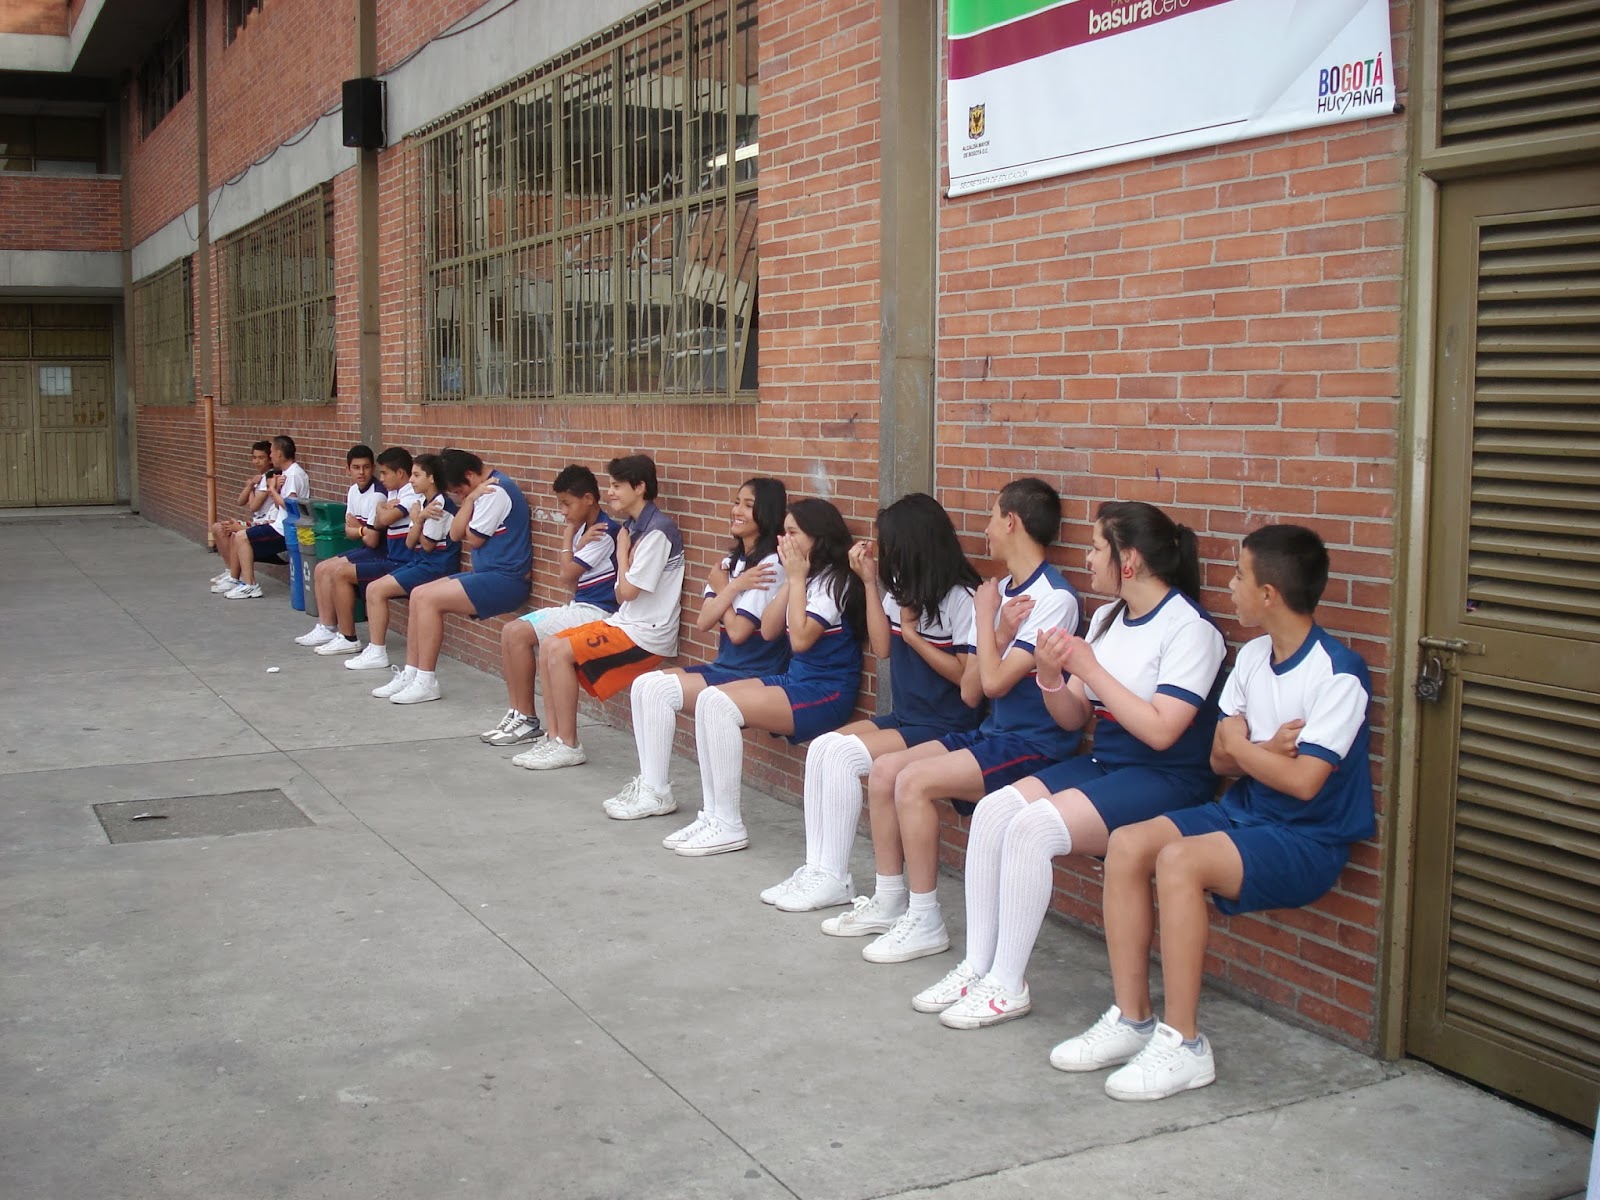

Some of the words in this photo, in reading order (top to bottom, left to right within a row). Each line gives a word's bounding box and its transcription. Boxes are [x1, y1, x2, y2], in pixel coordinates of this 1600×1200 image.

[1318, 51, 1384, 97] BOGOTÁ
[1317, 86, 1384, 115] HUMANA
[587, 634, 609, 648] 5
